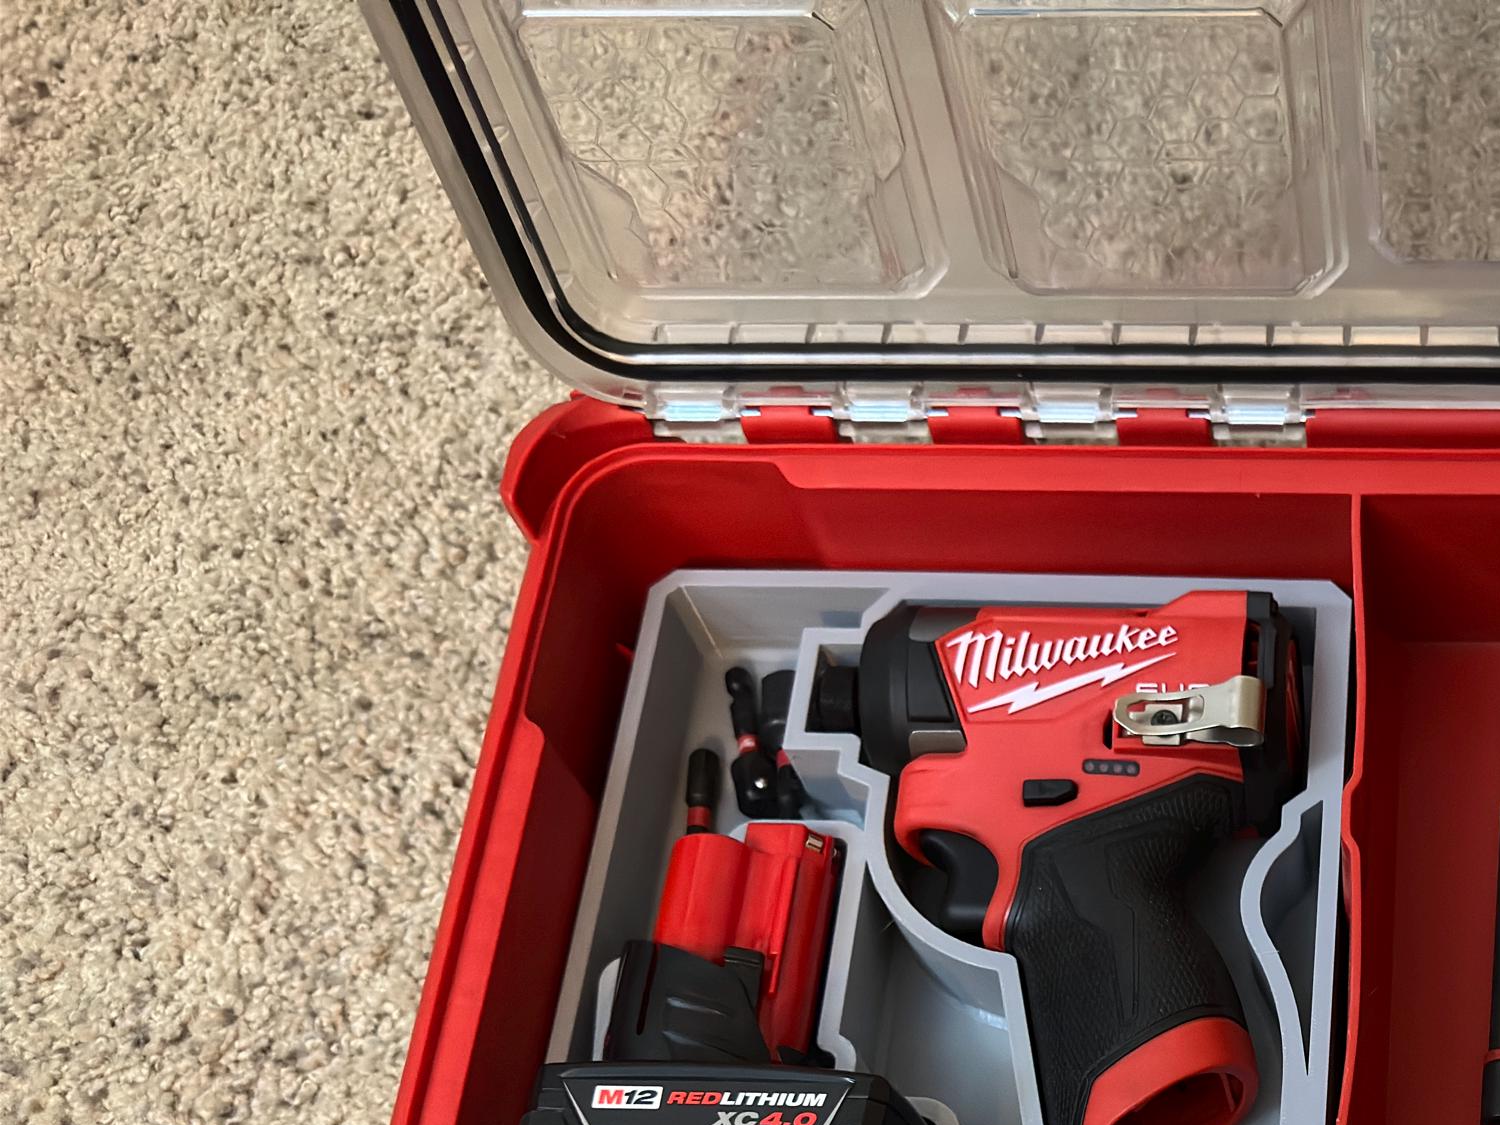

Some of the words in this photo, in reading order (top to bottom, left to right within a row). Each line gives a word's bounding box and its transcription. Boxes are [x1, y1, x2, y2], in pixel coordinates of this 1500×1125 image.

[946, 624, 1179, 689] Milwaukee
[597, 1088, 658, 1106] M12
[667, 1091, 827, 1107] REDLITHIUM
